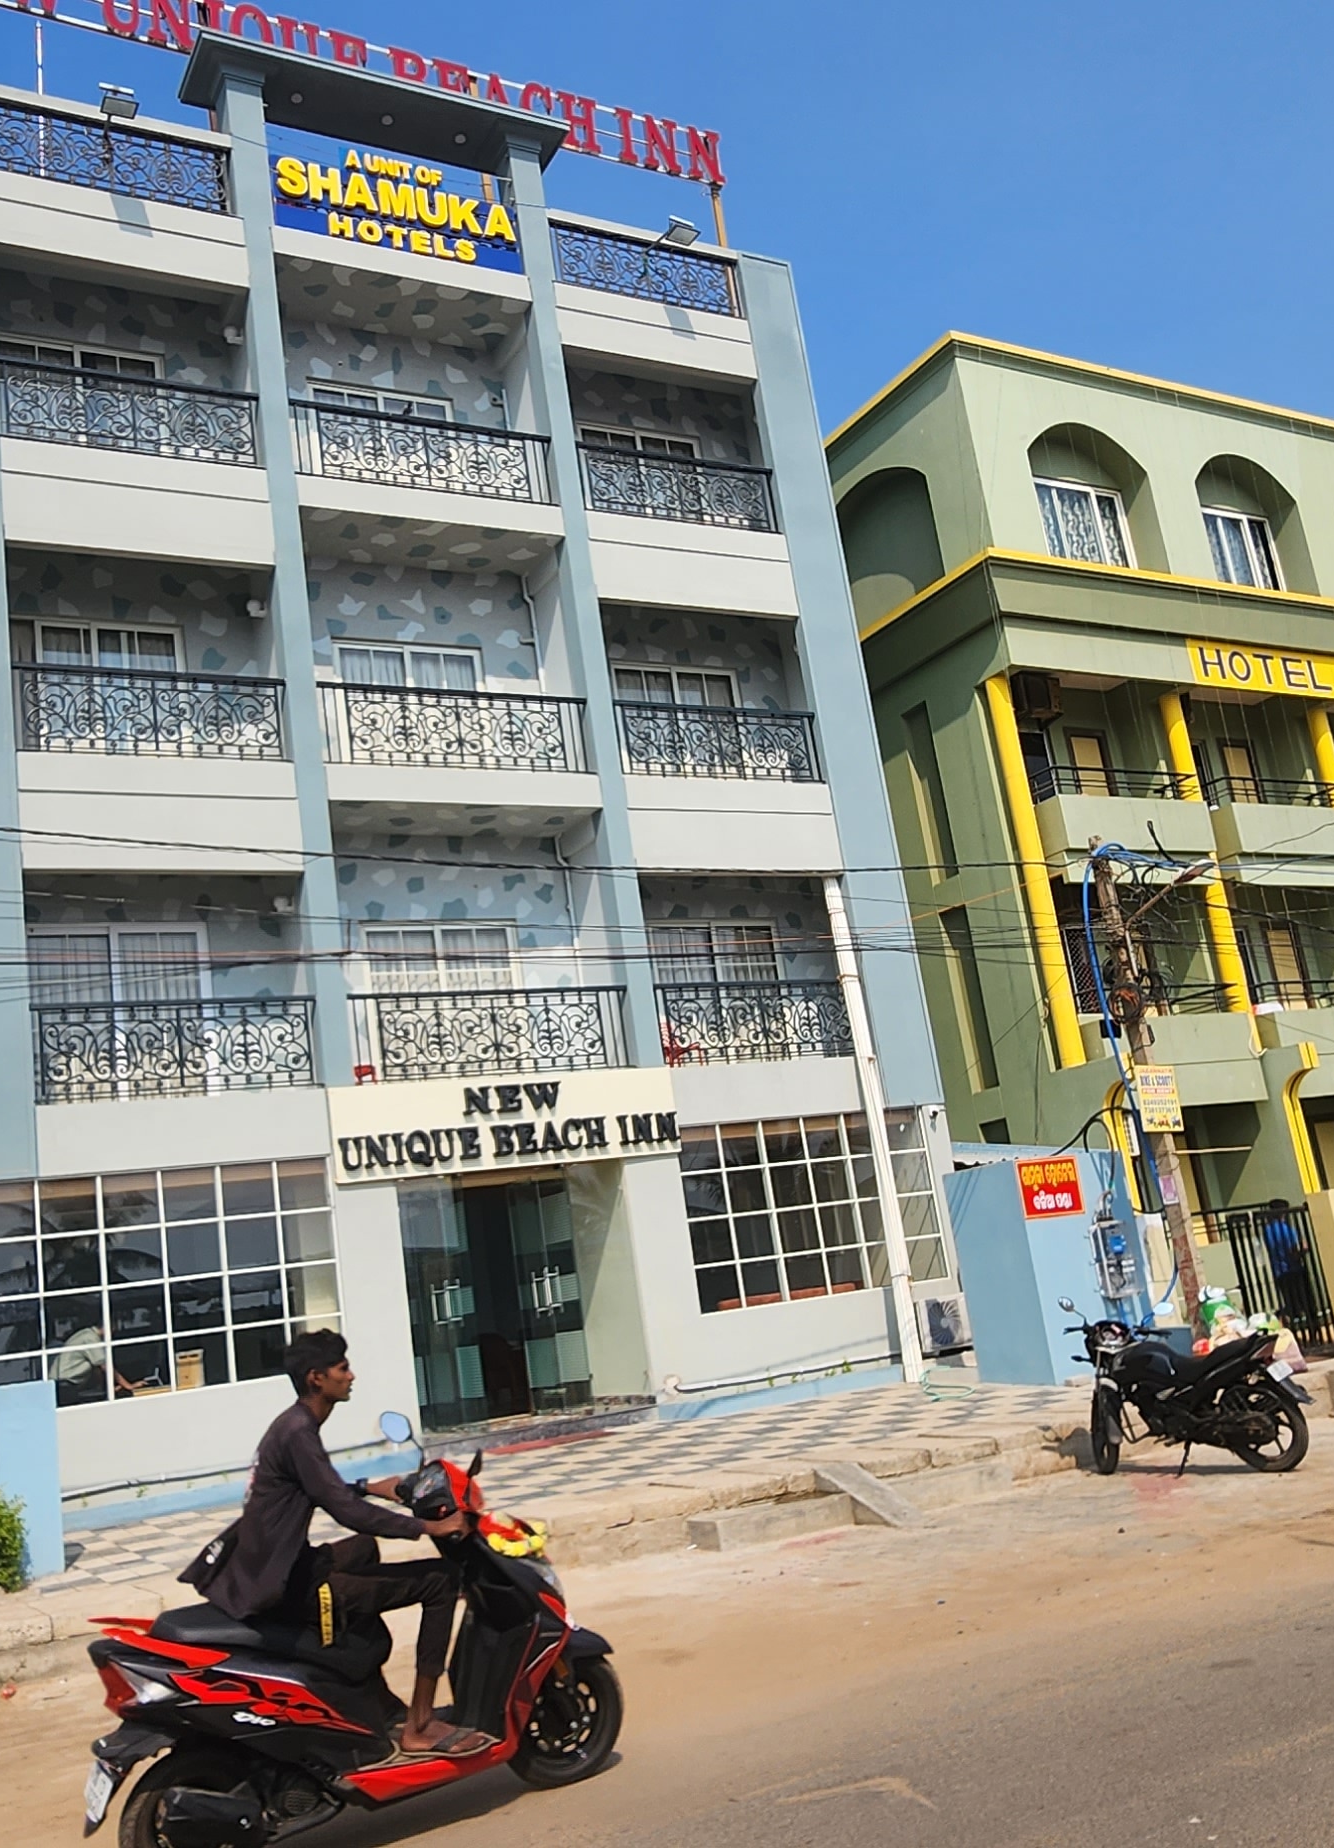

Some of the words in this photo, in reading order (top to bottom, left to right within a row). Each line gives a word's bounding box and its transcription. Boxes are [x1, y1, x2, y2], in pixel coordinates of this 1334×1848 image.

[344, 149, 362, 169] A
[363, 153, 413, 177] UNIT
[415, 165, 443, 187] OF
[611, 102, 728, 184] INN
[275, 156, 517, 244] SHAMUKA
[328, 211, 477, 264] HOTELS
[1197, 645, 1333, 693] HOTEL
[462, 1081, 562, 1116] NEW
[338, 1125, 481, 1171] UNIQUE
[491, 1115, 610, 1157] BEACH
[616, 1111, 681, 1146] INN
